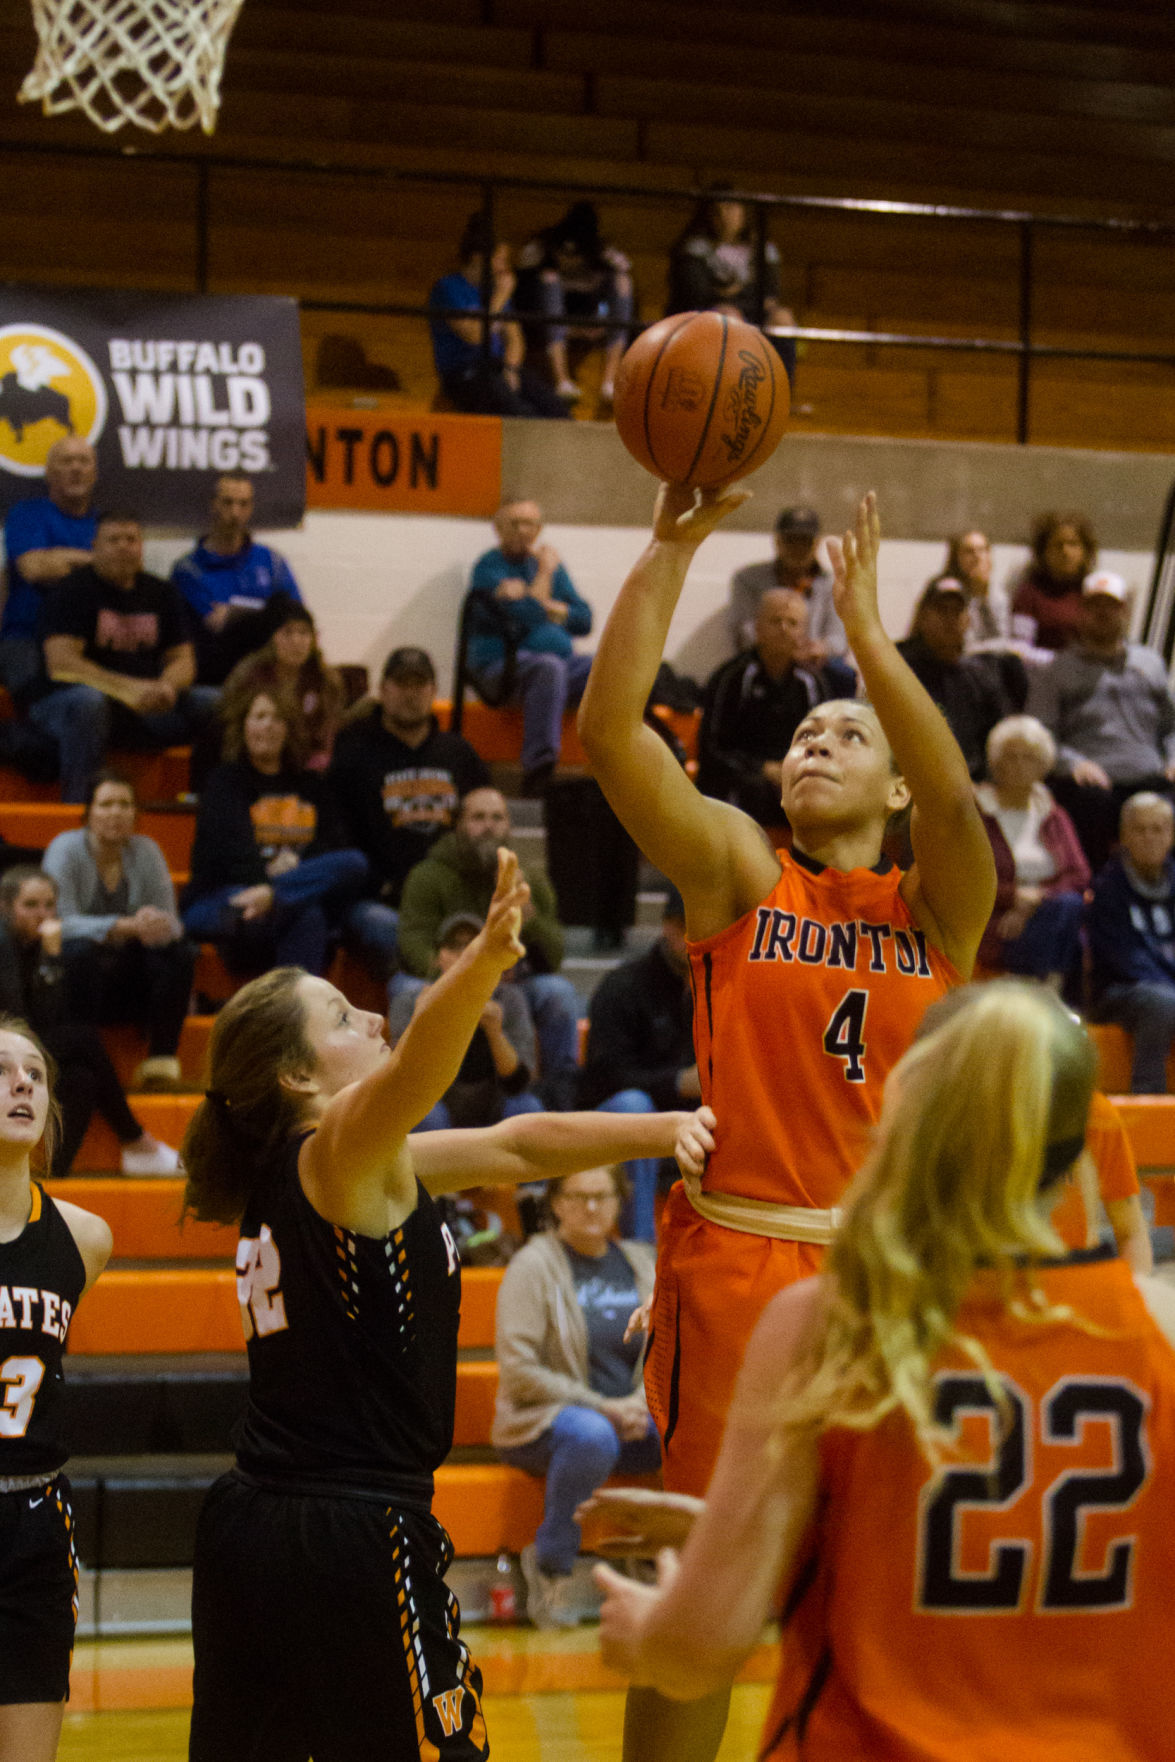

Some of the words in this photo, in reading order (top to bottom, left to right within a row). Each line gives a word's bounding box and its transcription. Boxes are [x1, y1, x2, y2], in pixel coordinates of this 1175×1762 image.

[108, 338, 266, 375] BUFFALO
[111, 372, 272, 428] WILD
[721, 349, 766, 463] Rawlings
[118, 425, 270, 472] WINGS
[822, 988, 869, 1083] 4
[913, 1368, 1154, 1615] 22
[432, 1684, 466, 1738] W
